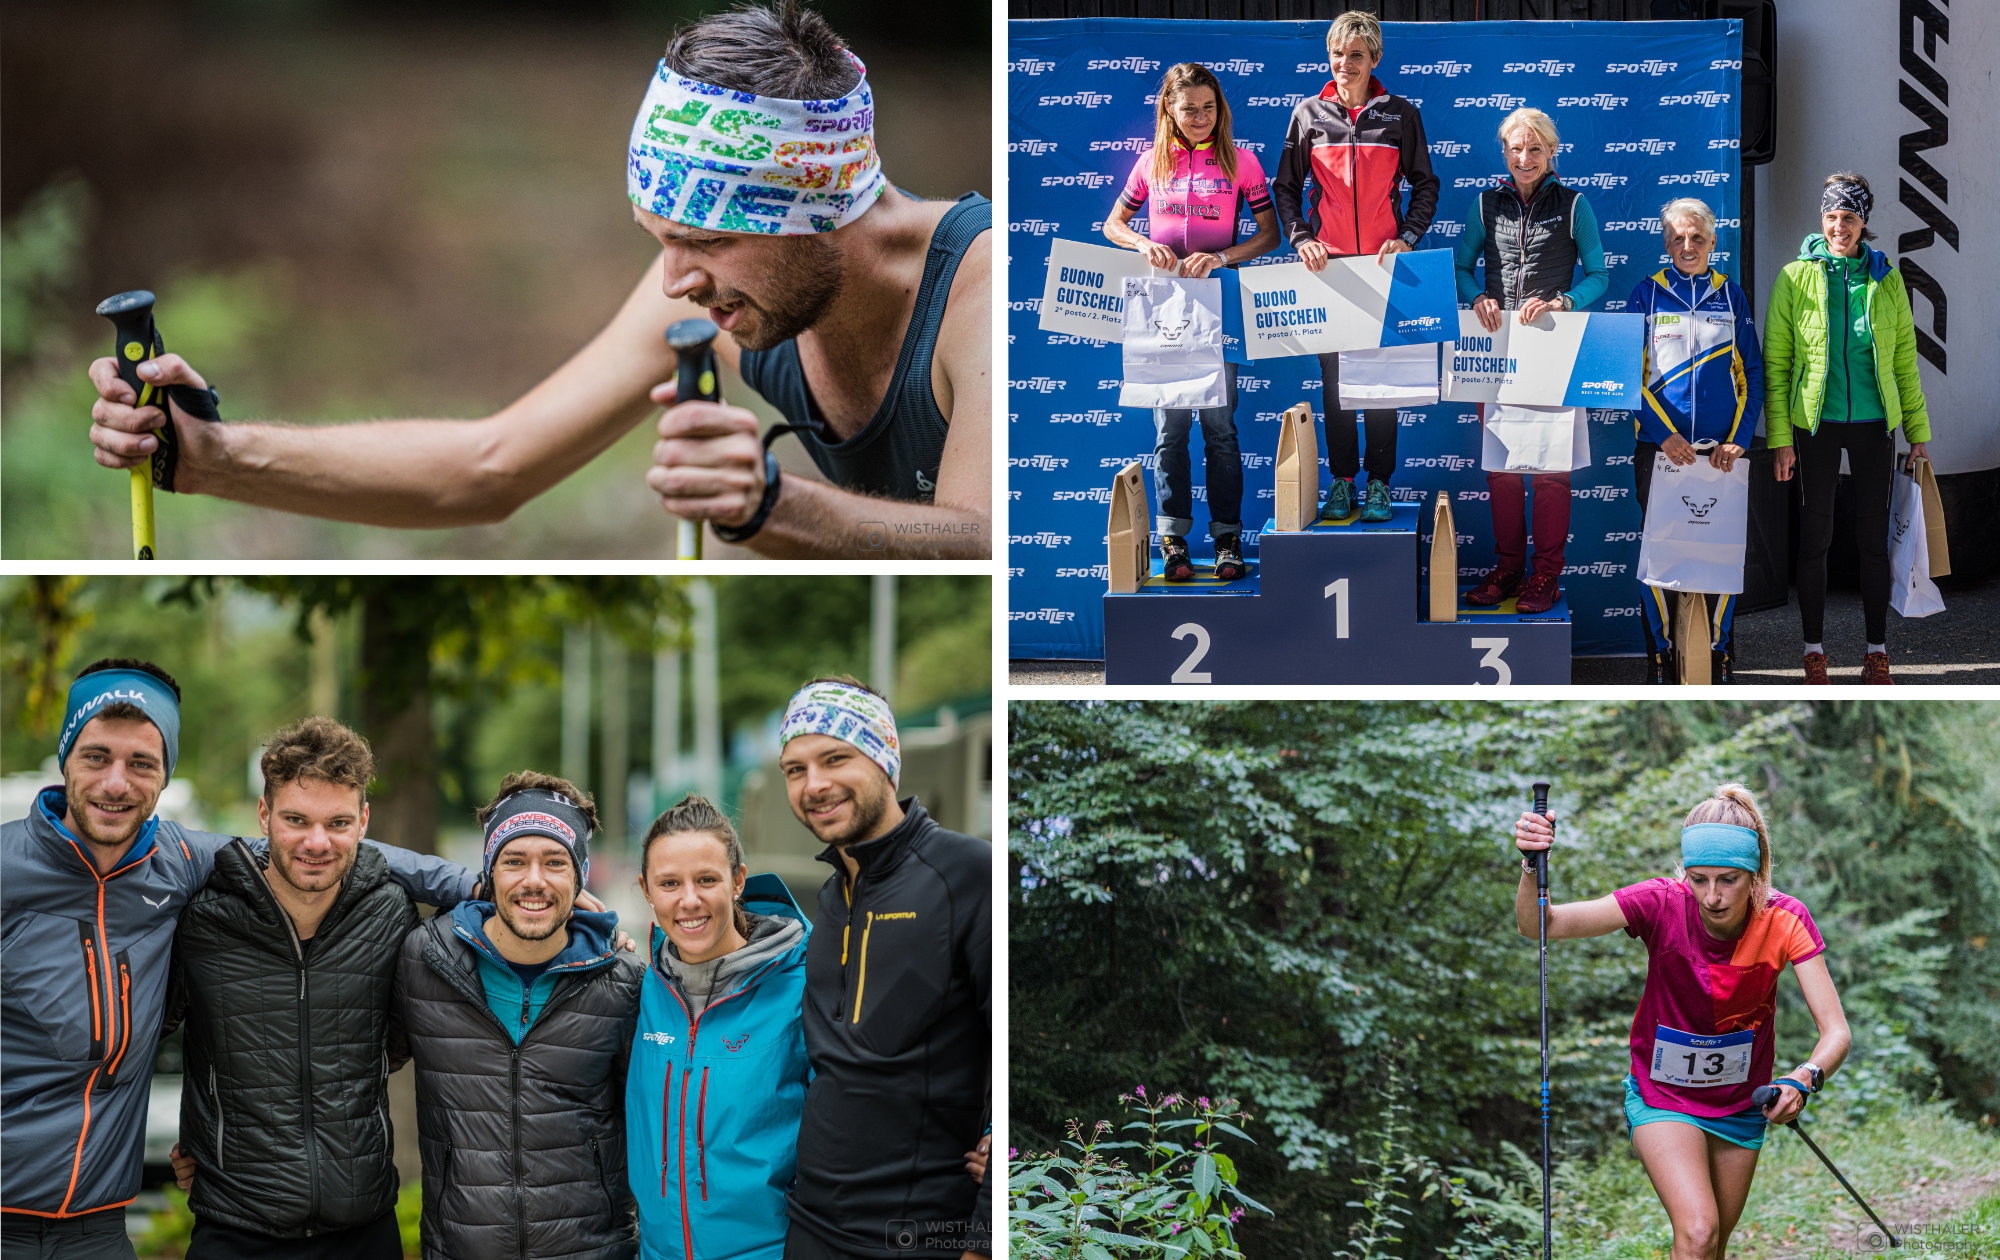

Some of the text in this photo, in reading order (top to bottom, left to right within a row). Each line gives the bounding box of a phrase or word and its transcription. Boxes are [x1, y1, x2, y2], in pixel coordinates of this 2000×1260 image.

[1087, 57, 1161, 74] SPORTLER
[1399, 60, 1473, 77] SPORTLER
[1503, 60, 1576, 77] SPORTLER
[1605, 60, 1678, 76] SPORTLER
[1038, 91, 1113, 109] SPORTLER
[1453, 94, 1527, 110] SPORTLER
[1557, 94, 1629, 110] SPORTLER
[1659, 91, 1731, 108] SPORTLER
[1604, 139, 1677, 155] SPORTLER
[1041, 172, 1115, 189] SPORTLER
[1658, 170, 1730, 187] SPORTLER
[1060, 267, 1104, 288] BUONO
[1253, 289, 1297, 308] BUONO
[1101, 314, 1122, 324] Platz
[1255, 307, 1328, 328] GUTSCHEIN
[1454, 336, 1493, 353] BUONO
[1453, 356, 1517, 374] GUTSCHEIN
[1050, 410, 1122, 426] SPORTLER
[1404, 454, 1475, 471] SPORTLER
[1324, 578, 1350, 639] 1
[1171, 622, 1212, 684] 2
[1471, 637, 1512, 685] 3
[58, 689, 147, 758] SKYWALK
[1683, 1052, 1726, 1076] 13
